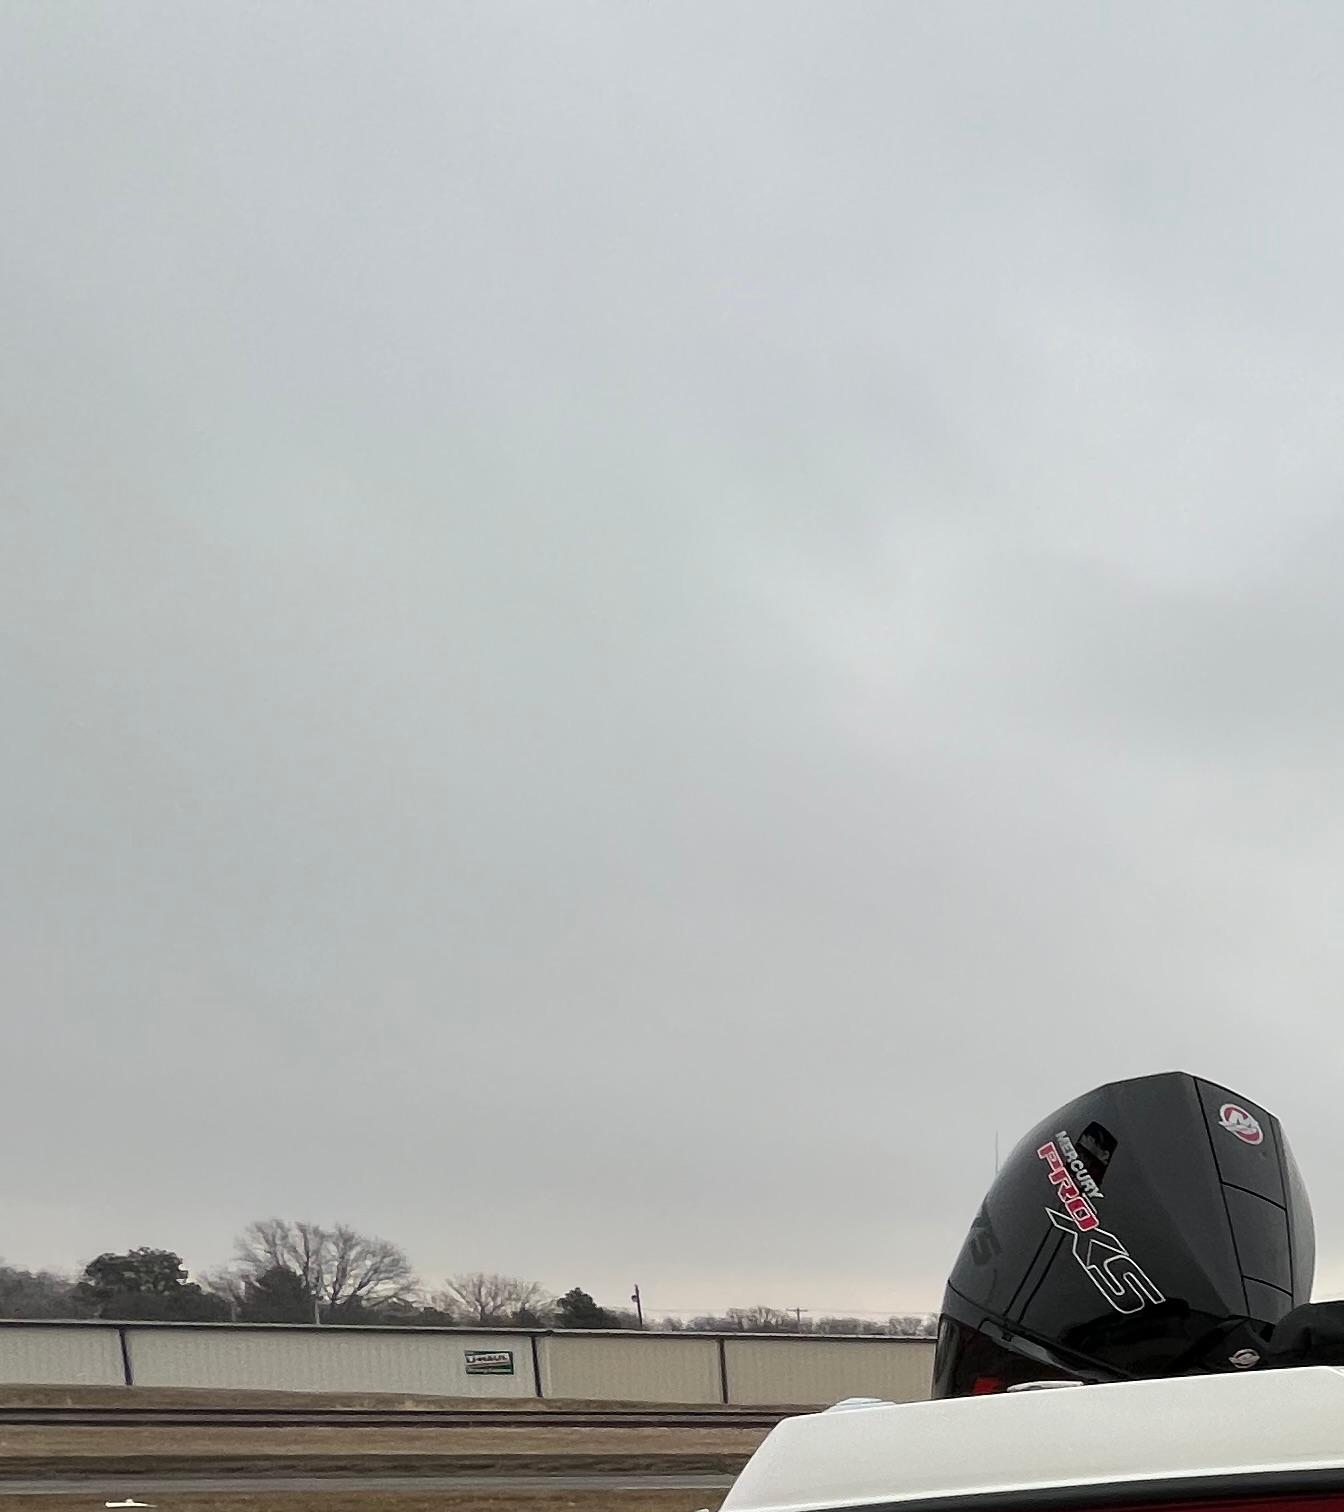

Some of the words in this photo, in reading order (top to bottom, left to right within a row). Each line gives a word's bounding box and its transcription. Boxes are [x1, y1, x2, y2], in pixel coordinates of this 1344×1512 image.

[1037, 1141, 1100, 1232] PRO
[1055, 1130, 1105, 1198] MERCURY
[1045, 1206, 1167, 1315] XS
